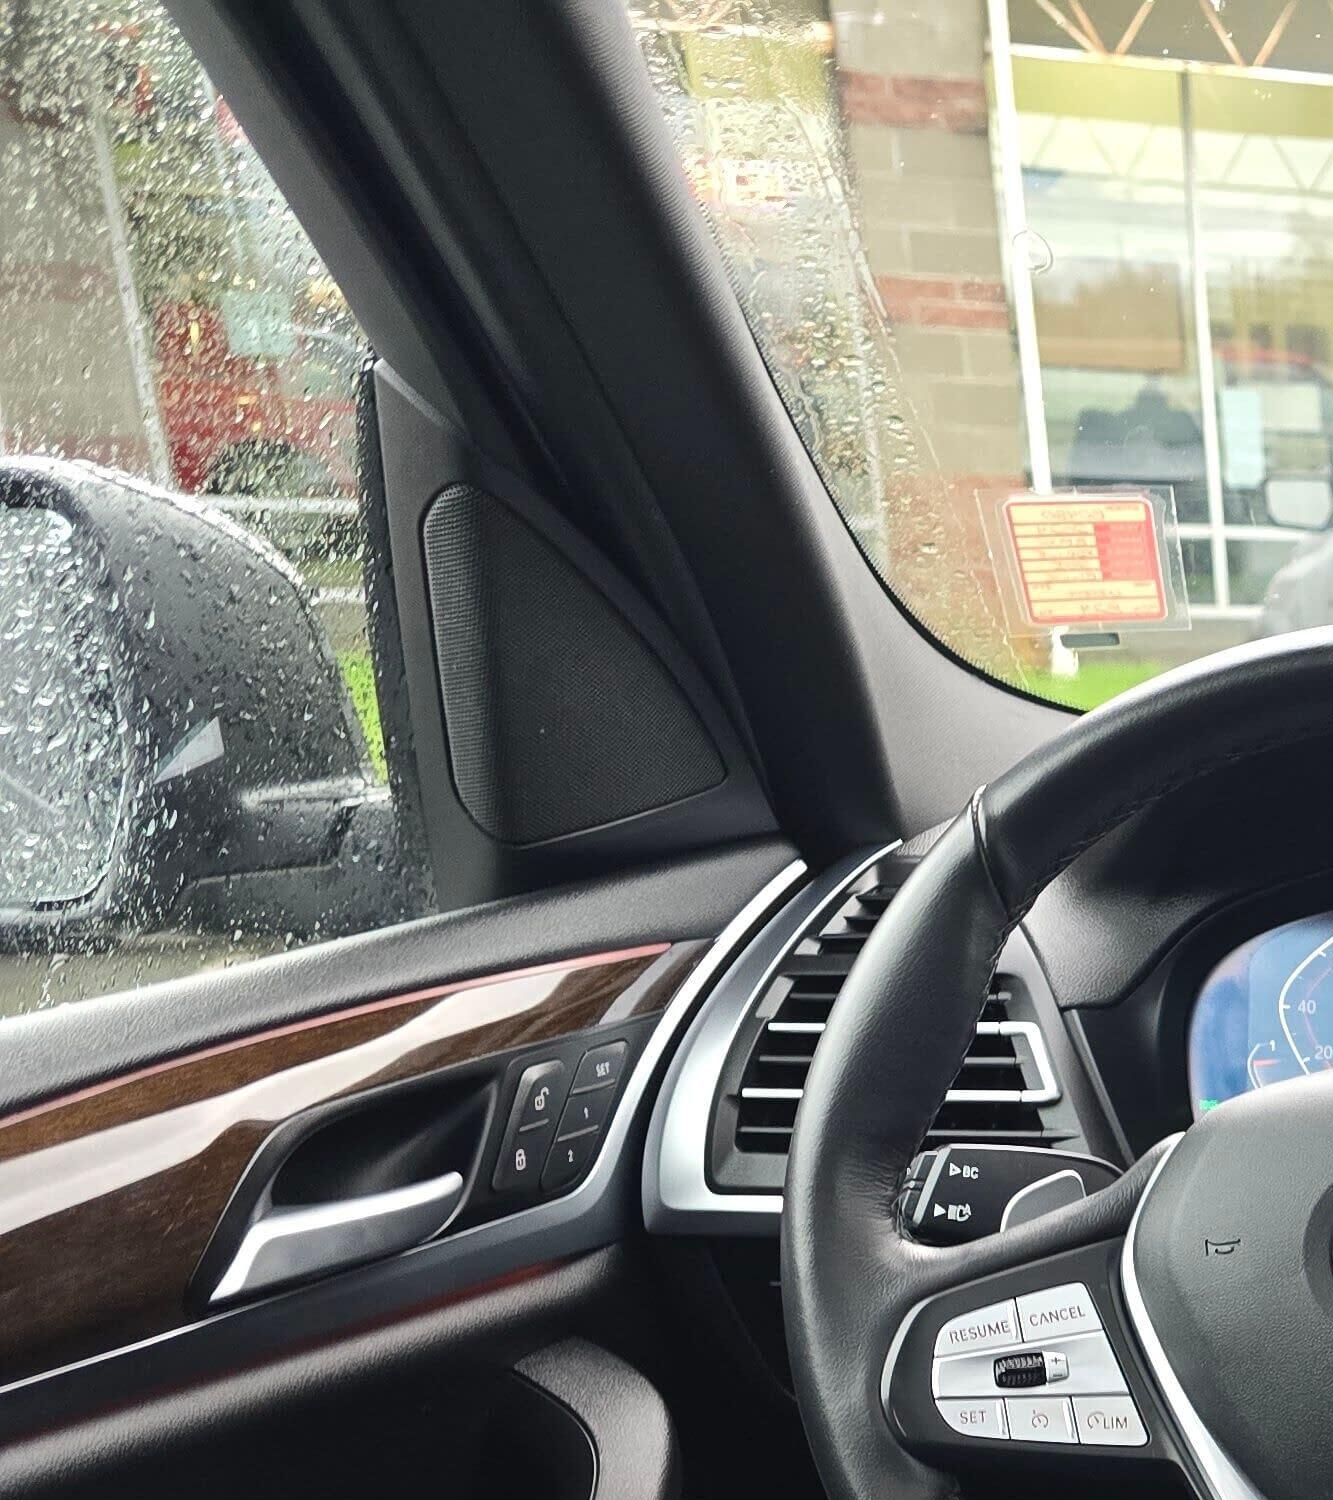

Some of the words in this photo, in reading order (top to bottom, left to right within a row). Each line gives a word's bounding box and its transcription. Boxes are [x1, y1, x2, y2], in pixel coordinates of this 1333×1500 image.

[1297, 1000, 1317, 1016] 40
[1313, 1045, 1333, 1061] 20
[595, 1061, 611, 1078] SET
[1029, 1305, 1087, 1327] CANCEL
[949, 1319, 1011, 1345] RESUME
[959, 1410, 988, 1425] SET
[1103, 1415, 1129, 1430] LIM
